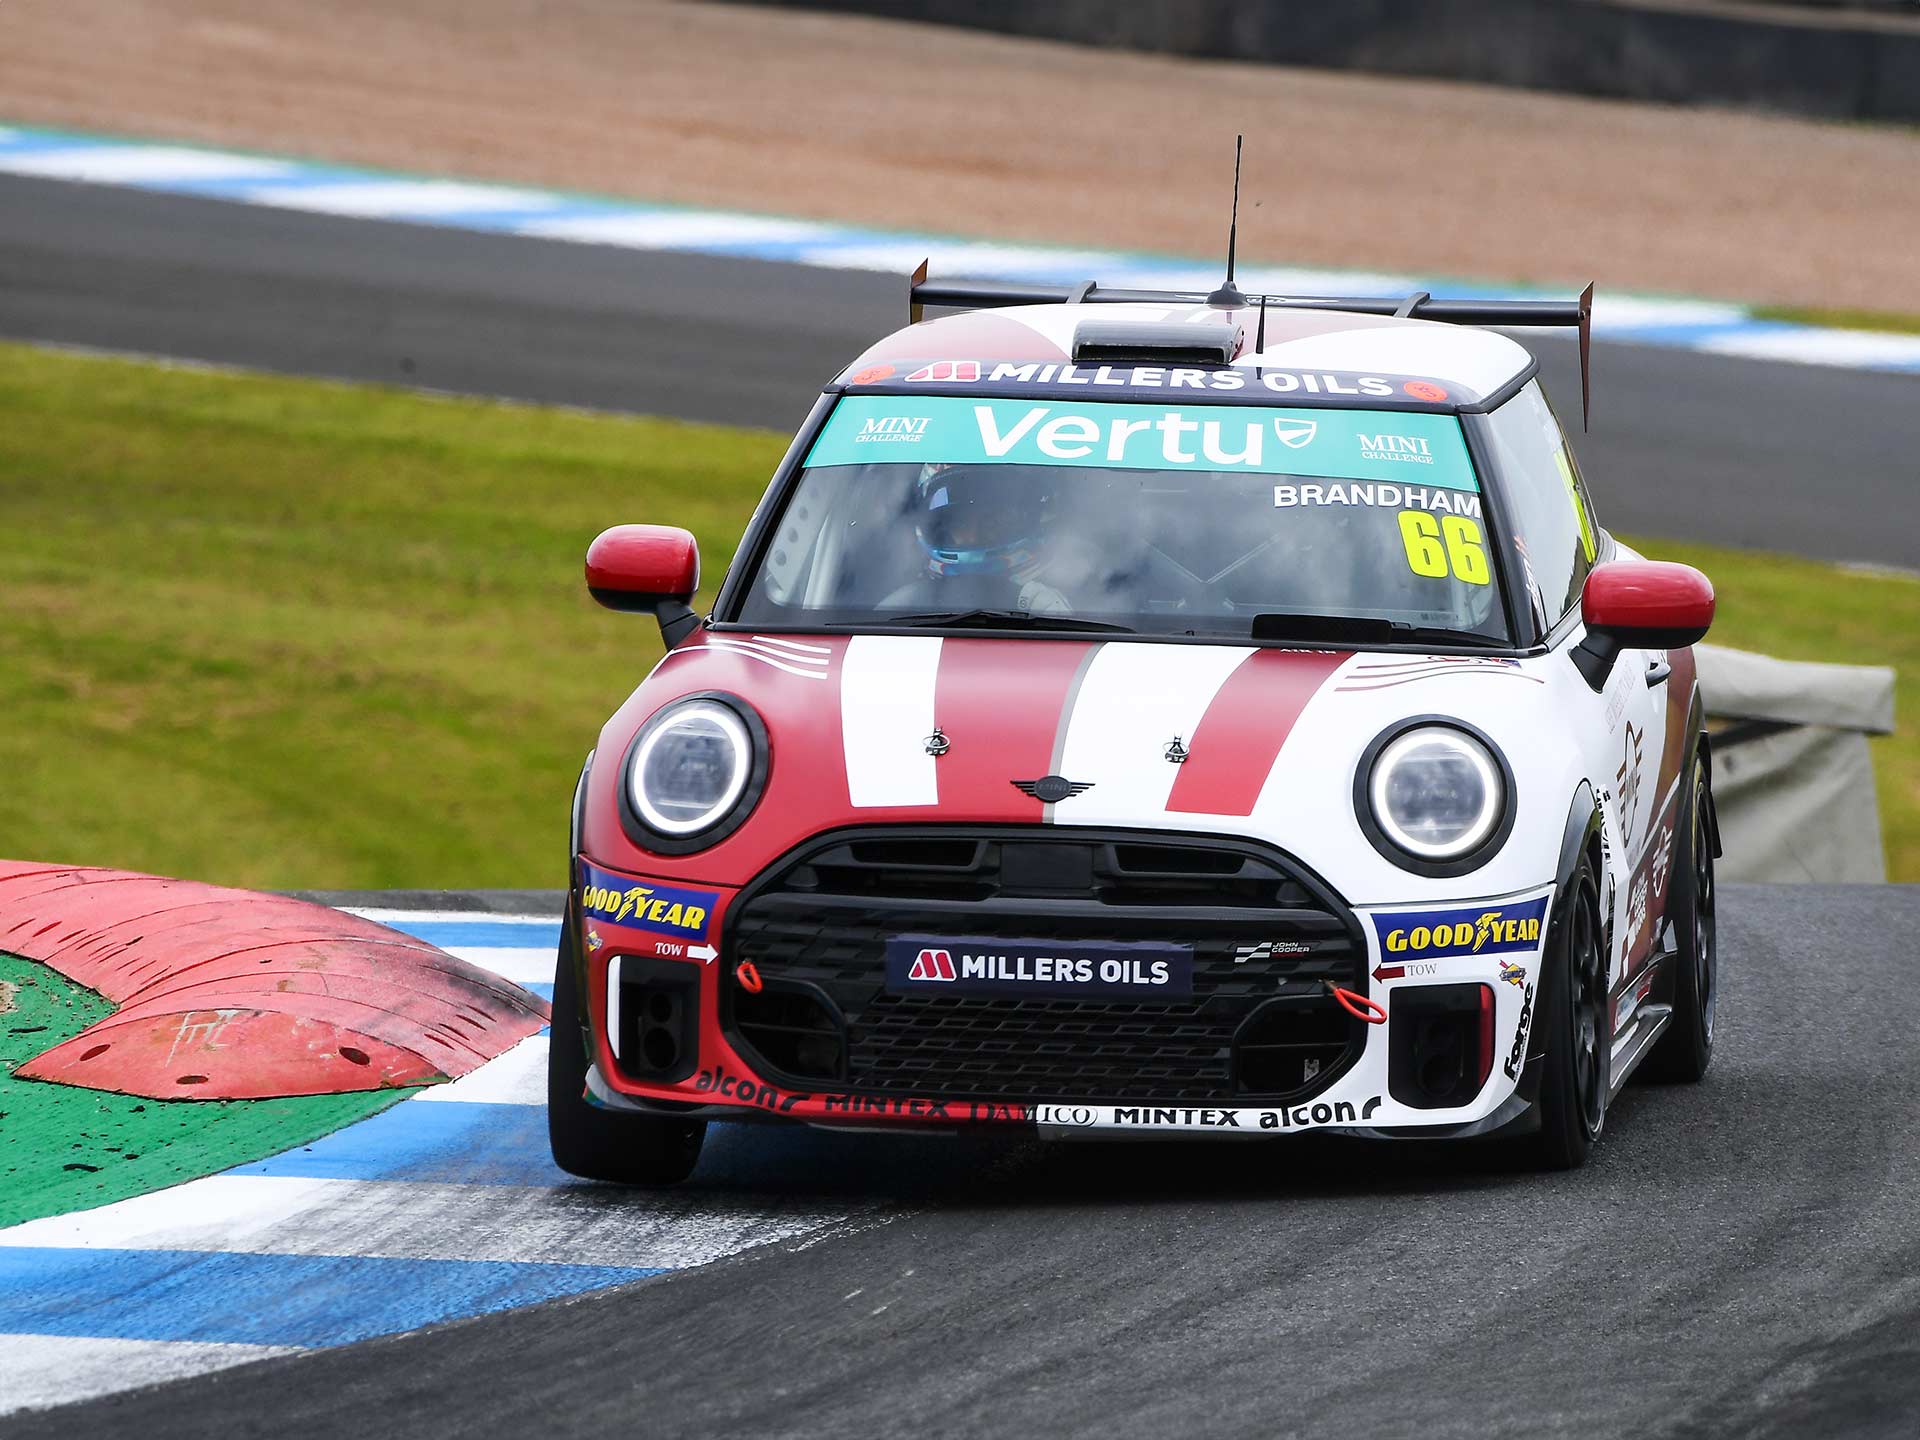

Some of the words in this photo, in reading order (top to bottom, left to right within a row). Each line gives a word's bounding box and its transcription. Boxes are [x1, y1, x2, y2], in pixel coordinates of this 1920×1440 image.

[988, 363, 1247, 391] MILLERS
[1263, 372, 1394, 396] OILS
[855, 434, 923, 443] CHALLENGE
[858, 417, 933, 434] MINI
[974, 406, 1263, 466] Vertu
[1356, 433, 1432, 456] MINI
[1361, 451, 1434, 465] CHALLENGE
[1273, 483, 1481, 519] BRANDHAM
[1397, 509, 1490, 586] 66
[1385, 914, 1540, 952] GOODYEAR
[655, 942, 684, 956] TOW
[961, 955, 1093, 983] MILLERS
[1099, 959, 1170, 985] OILS
[1407, 963, 1438, 977] TOW
[696, 1066, 778, 1109] alcon
[824, 1094, 949, 1118] MINTEX
[1113, 1108, 1240, 1127] MINTEX
[1259, 1101, 1357, 1129] alcon
